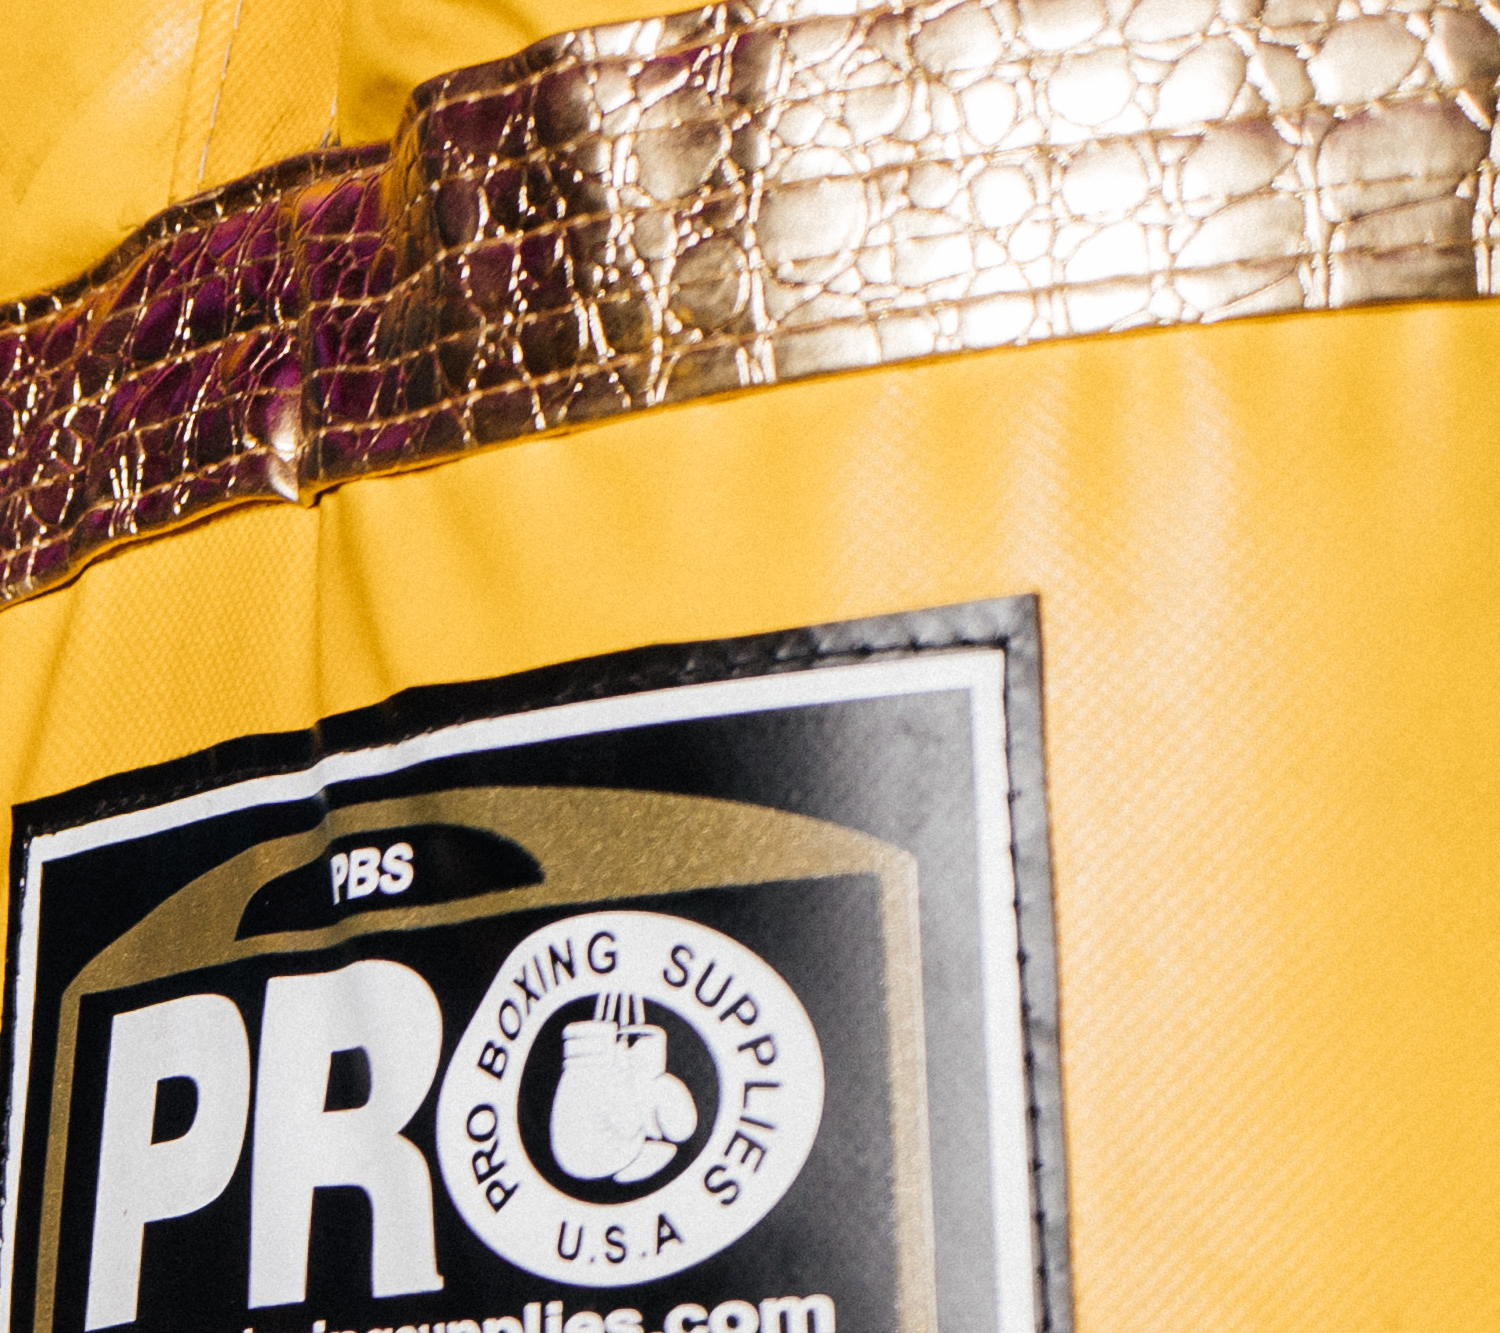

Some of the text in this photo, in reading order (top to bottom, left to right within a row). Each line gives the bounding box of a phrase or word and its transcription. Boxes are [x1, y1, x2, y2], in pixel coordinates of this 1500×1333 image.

[331, 844, 415, 905] PBS
[466, 931, 781, 1213] PRO BOXING SUPPLIES
[557, 1212, 685, 1264] U.S.A
